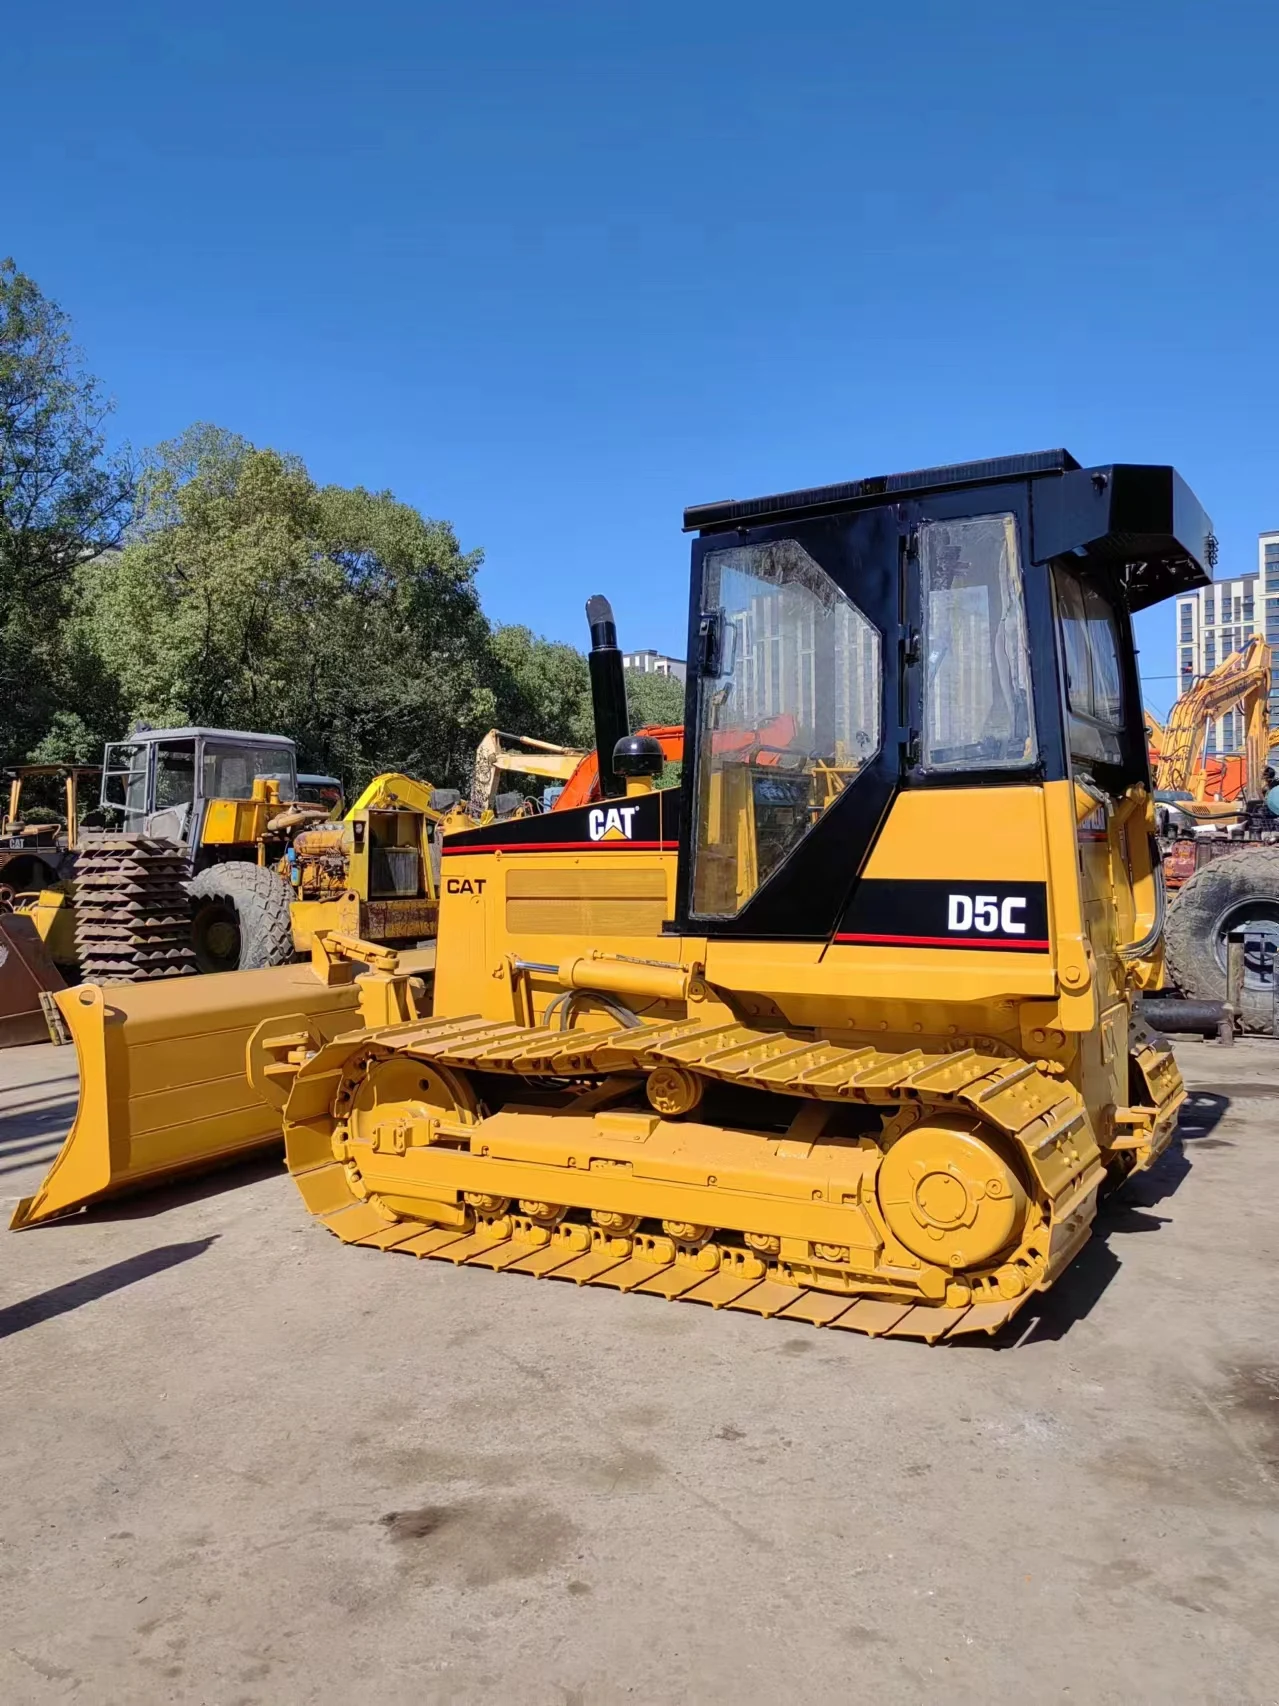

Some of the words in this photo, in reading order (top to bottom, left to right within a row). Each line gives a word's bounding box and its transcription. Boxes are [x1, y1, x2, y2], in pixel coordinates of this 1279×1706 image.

[588, 807, 637, 841] CAT
[9, 838, 25, 849] CAT
[447, 879, 487, 895] CAT
[948, 894, 1027, 934] D5C
